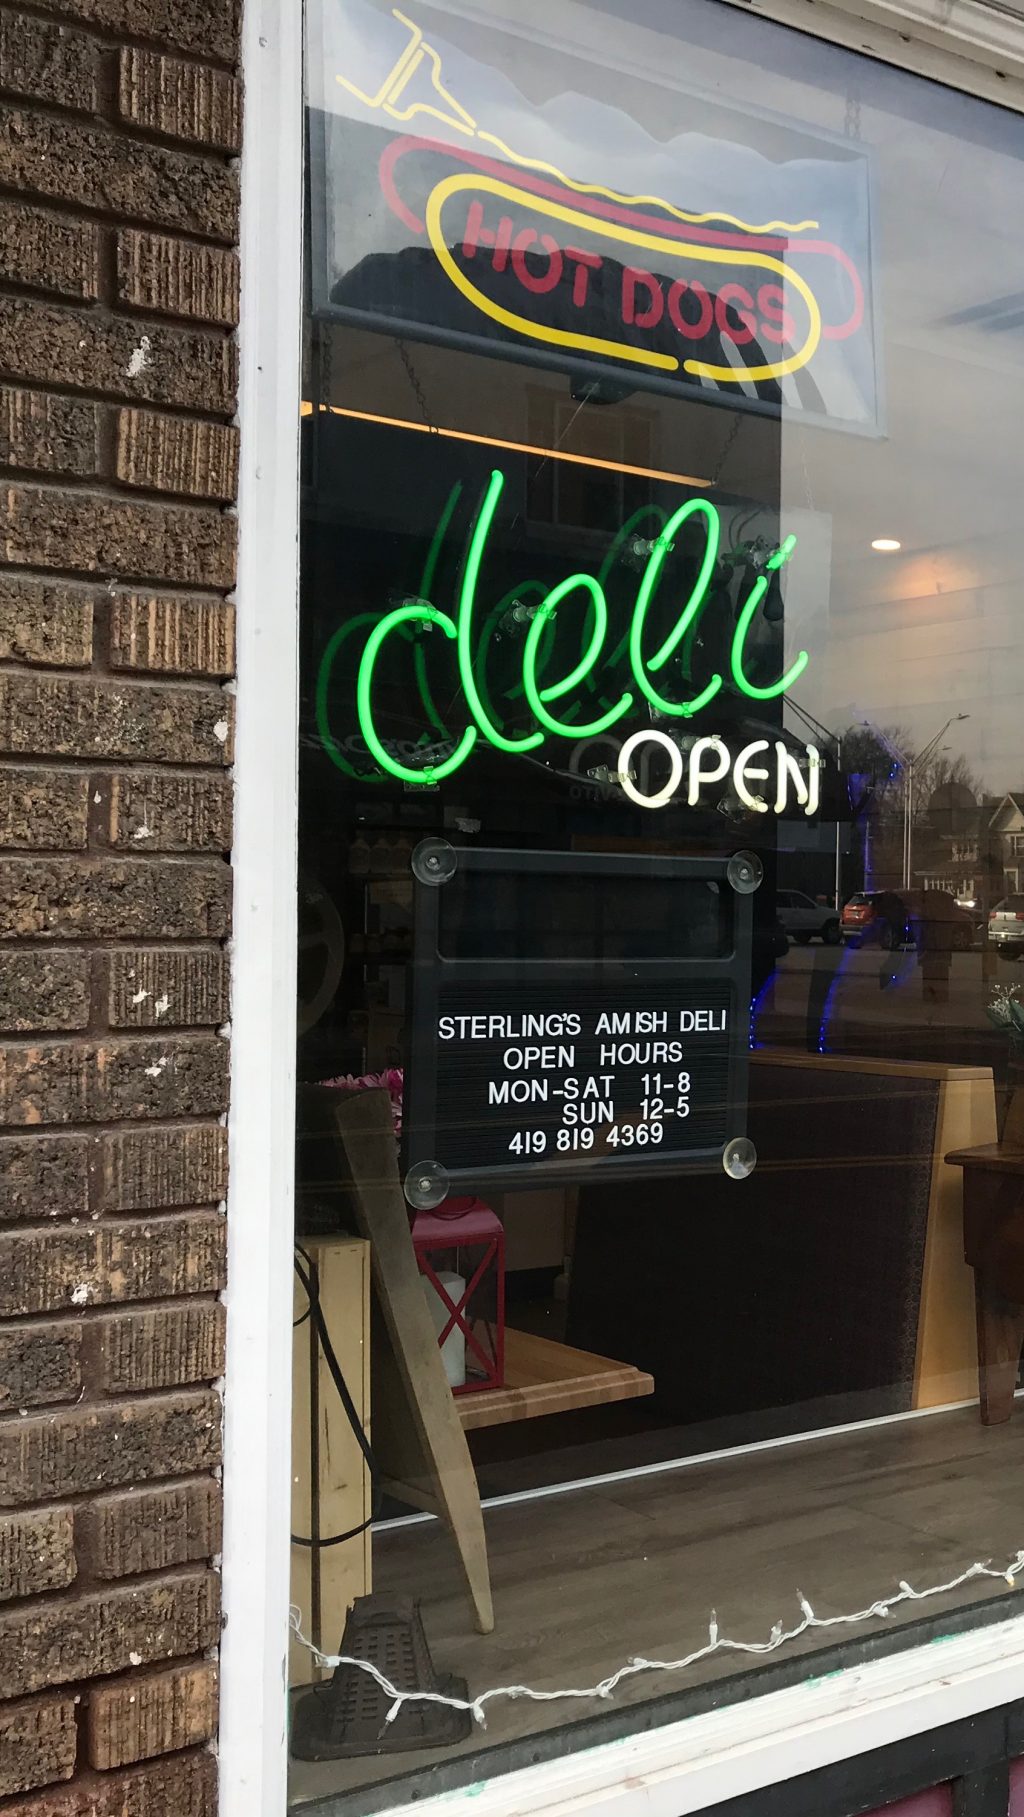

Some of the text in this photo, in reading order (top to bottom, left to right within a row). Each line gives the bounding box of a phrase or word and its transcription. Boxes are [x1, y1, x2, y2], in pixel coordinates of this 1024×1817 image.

[460, 200, 797, 346] HOT DOGS
[357, 469, 809, 784] deli
[618, 729, 820, 816] OPEN
[438, 1009, 727, 1040] STERLING'S AMISH DELI
[503, 1042, 683, 1070] OPEN HOURS
[488, 1072, 691, 1105] MON-SAT 11-8
[562, 1097, 690, 1126] SUN 12-5
[508, 1122, 664, 1155] 419 819 4369
